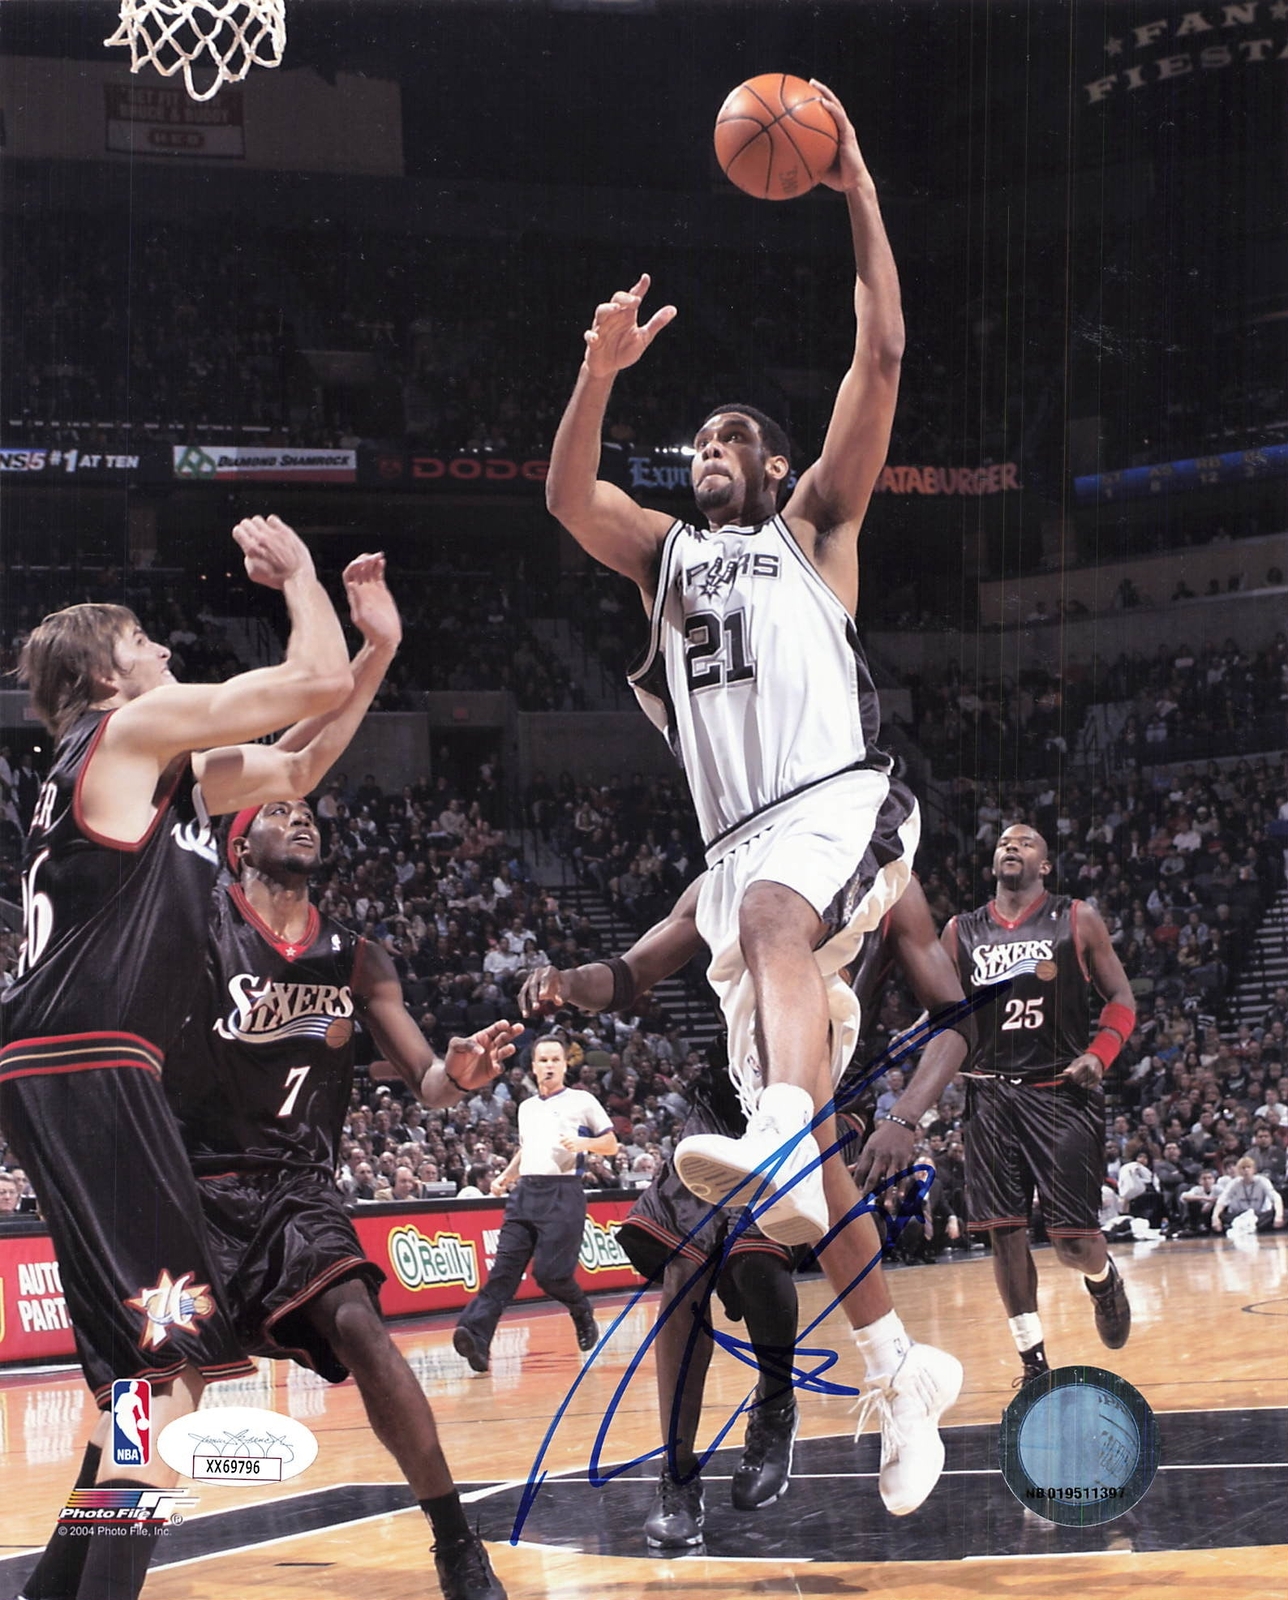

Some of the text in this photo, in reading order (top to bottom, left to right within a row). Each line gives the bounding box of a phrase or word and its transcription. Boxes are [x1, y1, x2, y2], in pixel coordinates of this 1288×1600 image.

[1133, 2, 1258, 48] FAN
[49, 449, 78, 472] #1
[79, 455, 101, 468] AT
[106, 455, 140, 468] TEN
[218, 455, 350, 467] DIAMOND SHAMROCK
[412, 457, 550, 479] DODG
[629, 456, 693, 488] Expr
[874, 463, 1018, 494] ATABURGER
[677, 553, 781, 600] PURS
[684, 607, 758, 695] 21
[18, 848, 54, 977] 6
[971, 940, 1054, 986] SIXERS
[213, 974, 354, 1041] SIXERS
[1001, 997, 1044, 1031] 25
[277, 1066, 311, 1118] 7
[393, 1231, 474, 1281] O'Reilly
[17, 1297, 73, 1332] PART
